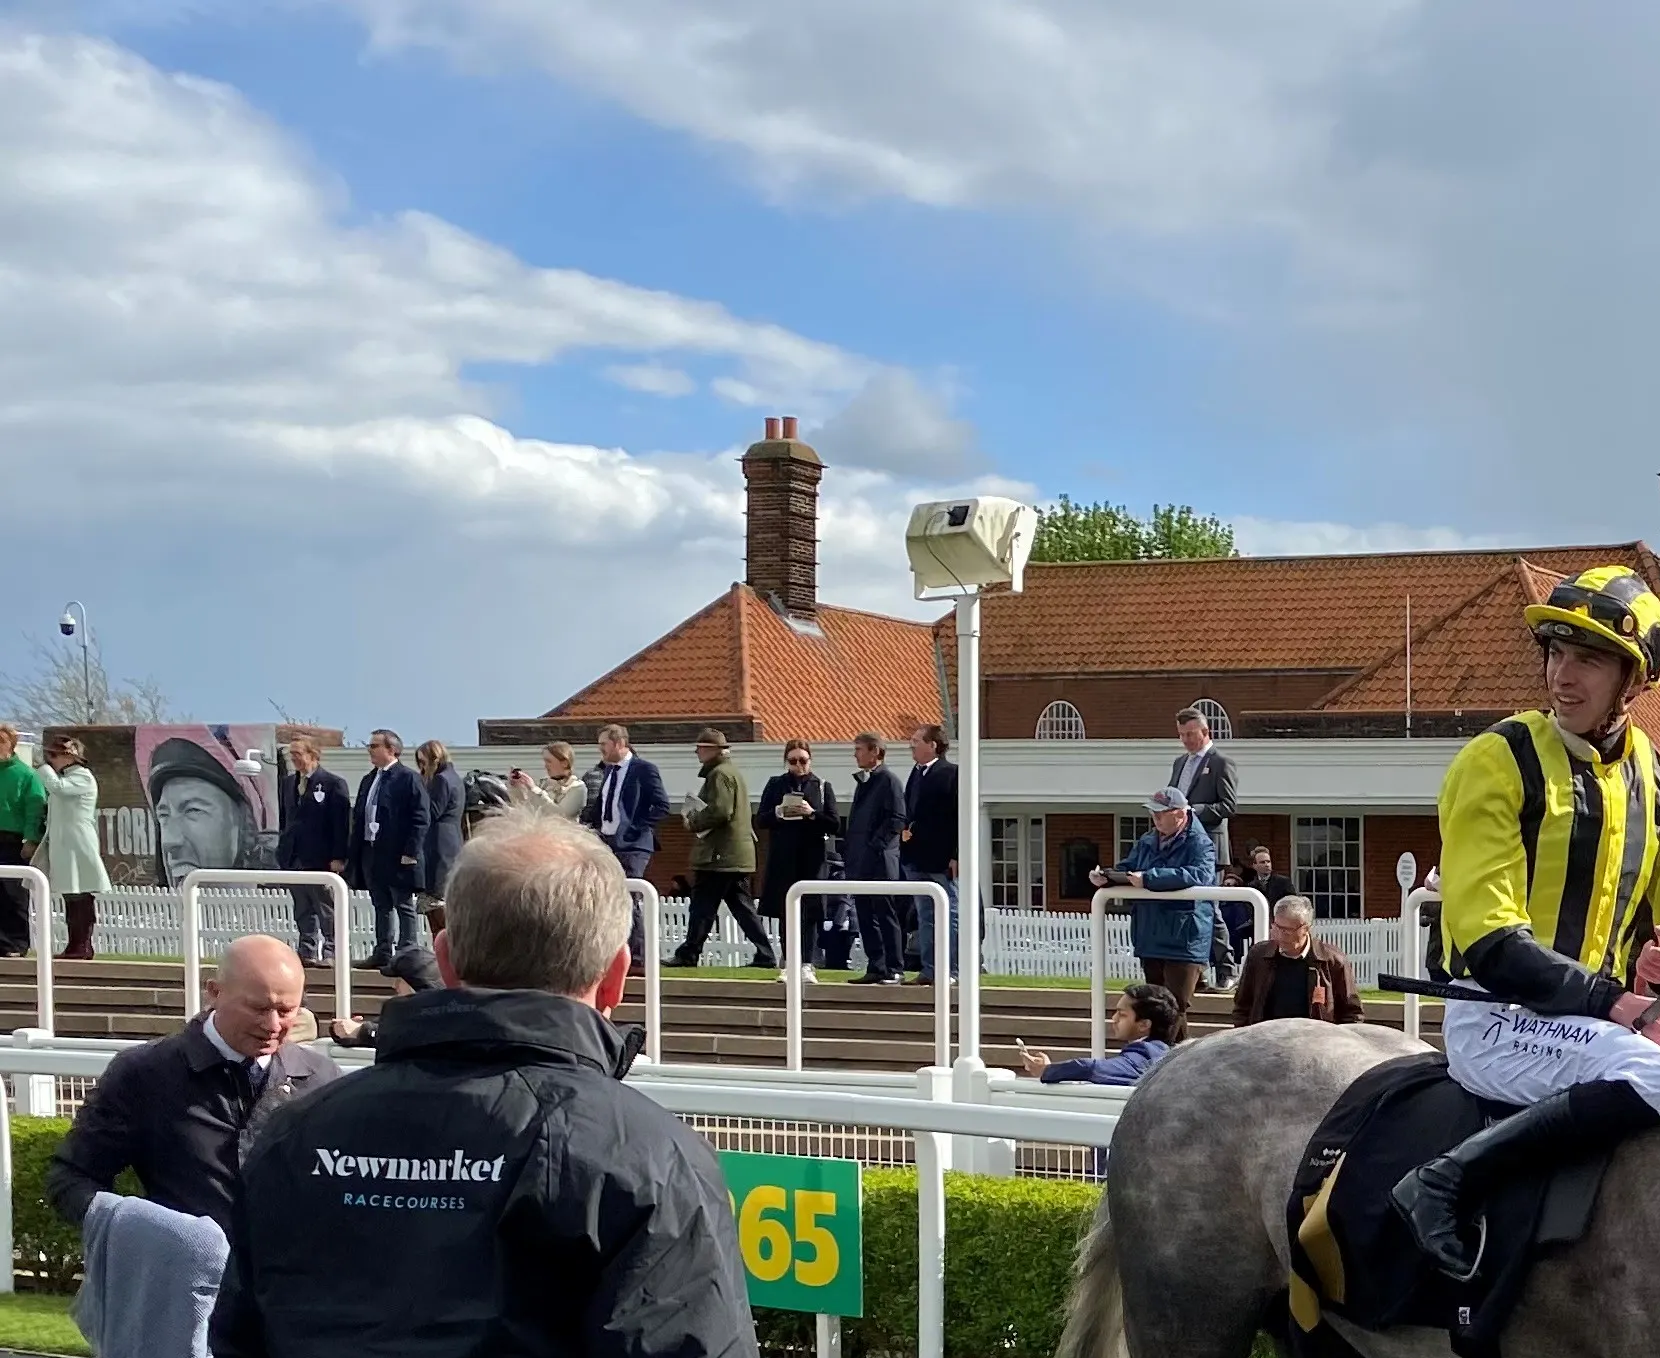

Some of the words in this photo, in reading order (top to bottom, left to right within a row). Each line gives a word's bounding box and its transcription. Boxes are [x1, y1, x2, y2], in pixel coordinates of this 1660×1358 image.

[1512, 1013, 1598, 1045] WATHNAN
[1513, 1040, 1563, 1059] RACING
[311, 1148, 506, 1182] Newmarket
[343, 1192, 465, 1210] RACECOURSES
[727, 1184, 840, 1288] 65
